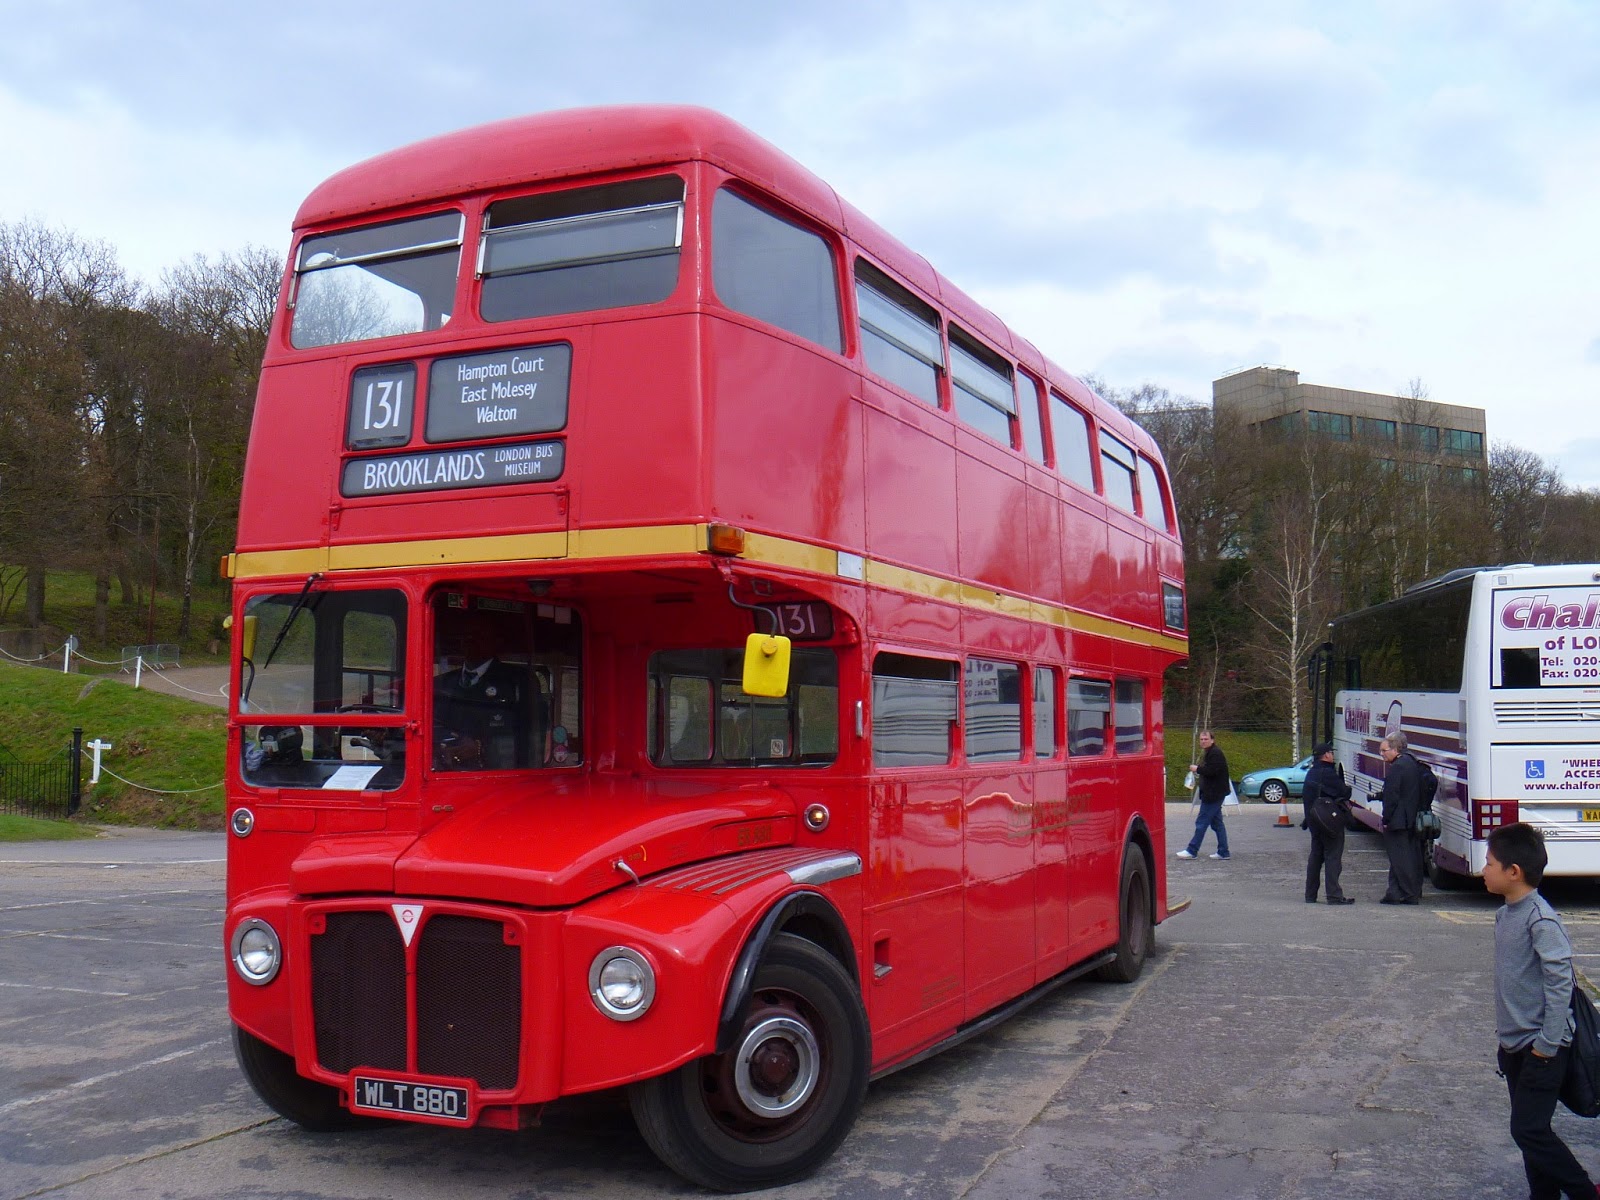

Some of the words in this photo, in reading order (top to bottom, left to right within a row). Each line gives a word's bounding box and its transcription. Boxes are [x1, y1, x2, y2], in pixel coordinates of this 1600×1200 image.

[457, 364, 507, 382] Hampton
[511, 356, 545, 374] Court
[461, 386, 488, 403] East
[491, 380, 538, 400] Molesey
[363, 380, 403, 430] 131
[476, 405, 518, 424] Walton
[494, 447, 532, 463] LONDON
[535, 444, 554, 459] BUS
[363, 452, 486, 490] BROOKLANDS
[504, 461, 541, 477] MUSEUM
[776, 604, 816, 635] 131
[1500, 594, 1600, 631] Chal
[1544, 636, 1566, 650] of
[1571, 636, 1600, 650] LO
[1541, 656, 1564, 666] Tel:
[1541, 669, 1569, 679] Fax:
[1564, 770, 1600, 779] ACCES
[1585, 811, 1600, 821] WA
[364, 1081, 408, 1109] WLT
[413, 1087, 458, 1116] 880
